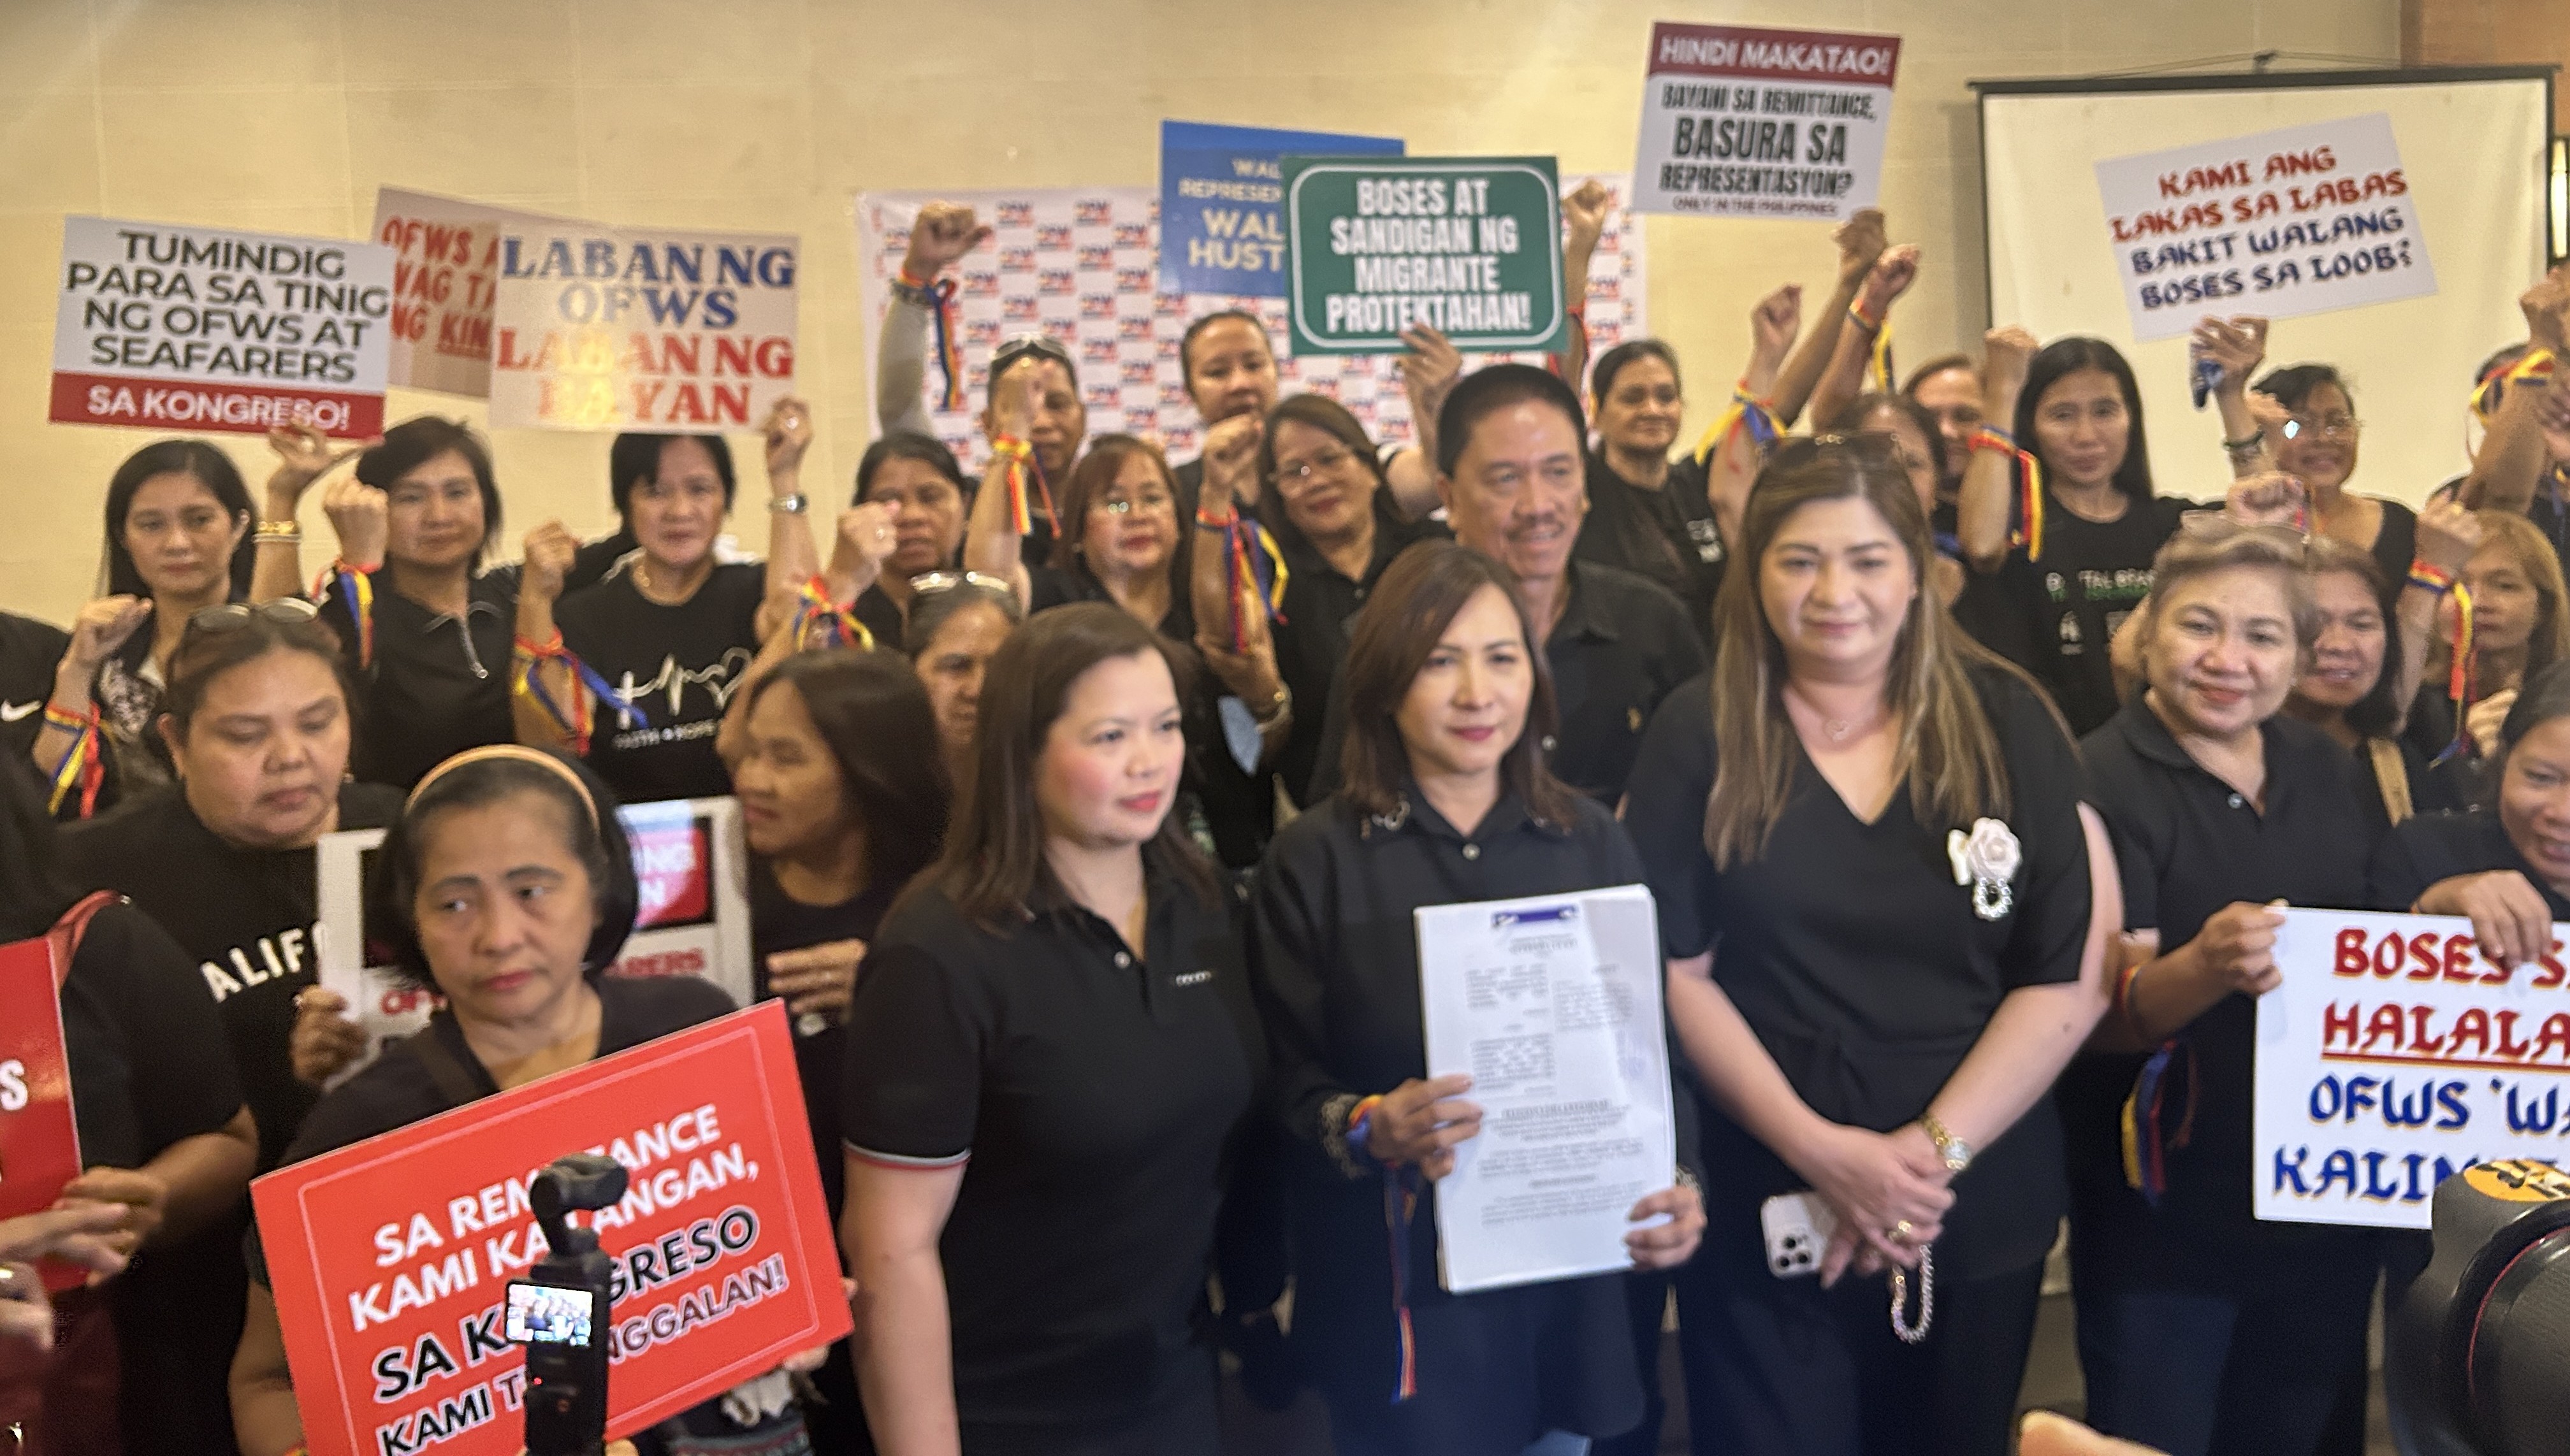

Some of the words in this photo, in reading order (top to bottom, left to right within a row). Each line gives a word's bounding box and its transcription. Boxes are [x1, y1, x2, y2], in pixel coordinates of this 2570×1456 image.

[1659, 33, 1739, 68] HINDI
[1741, 40, 1892, 76] MAKATAO!
[1662, 83, 1727, 111] BAYANI
[1732, 86, 1755, 112] SA
[1761, 87, 1876, 122] REMITTANCE,
[1672, 115, 1797, 162] BASURA
[1806, 124, 1848, 166] SA
[1659, 162, 1854, 199] REPRESENTASYON?
[2158, 160, 2251, 199] KAMI
[2265, 145, 2337, 183] ANG
[1356, 178, 1448, 216] BOSES
[1455, 179, 1490, 214] AT
[2109, 201, 2224, 242] LAKAS
[2231, 192, 2279, 224] SA
[2289, 169, 2409, 214] LABAS
[1202, 206, 1286, 241] WAL
[1330, 217, 1472, 255] SANDIGAN
[1479, 217, 1519, 254] NG
[2130, 232, 2239, 277] BAKIT
[2248, 206, 2404, 254] WALANG
[119, 230, 345, 279] TUMINDIG
[502, 237, 704, 284] LABAN
[716, 245, 795, 289] NG
[1188, 236, 1287, 273] HUST
[1354, 256, 1500, 292] MIGRANTE
[66, 262, 195, 301] PARA
[206, 272, 265, 309] SA
[276, 279, 389, 318] TINIG
[557, 282, 739, 329] OFWS
[2139, 272, 2244, 310] BOSES
[2253, 261, 2301, 292] SA
[83, 299, 151, 333] NG
[163, 303, 302, 344] OFWS
[312, 319, 371, 349] AT
[1326, 292, 1531, 333] PROTEKTAHAN!
[91, 335, 356, 384] SEAFARERS
[713, 335, 794, 378] NG
[87, 384, 140, 417] SA
[143, 389, 351, 431] KONGRESO!
[2531, 939, 2570, 989] S
[2323, 998, 2570, 1060] HALALA
[2309, 1072, 2471, 1130] OFWS
[2490, 1076, 2570, 1137] 'W
[374, 1212, 444, 1267] SA
[449, 1104, 721, 1238] REMANCE
[349, 1248, 479, 1332] KAMI
[486, 1142, 759, 1276] KAANGAN,
[374, 1331, 458, 1404] SA
[460, 1204, 760, 1371] KRESO
[376, 1384, 495, 1456] KAMI
